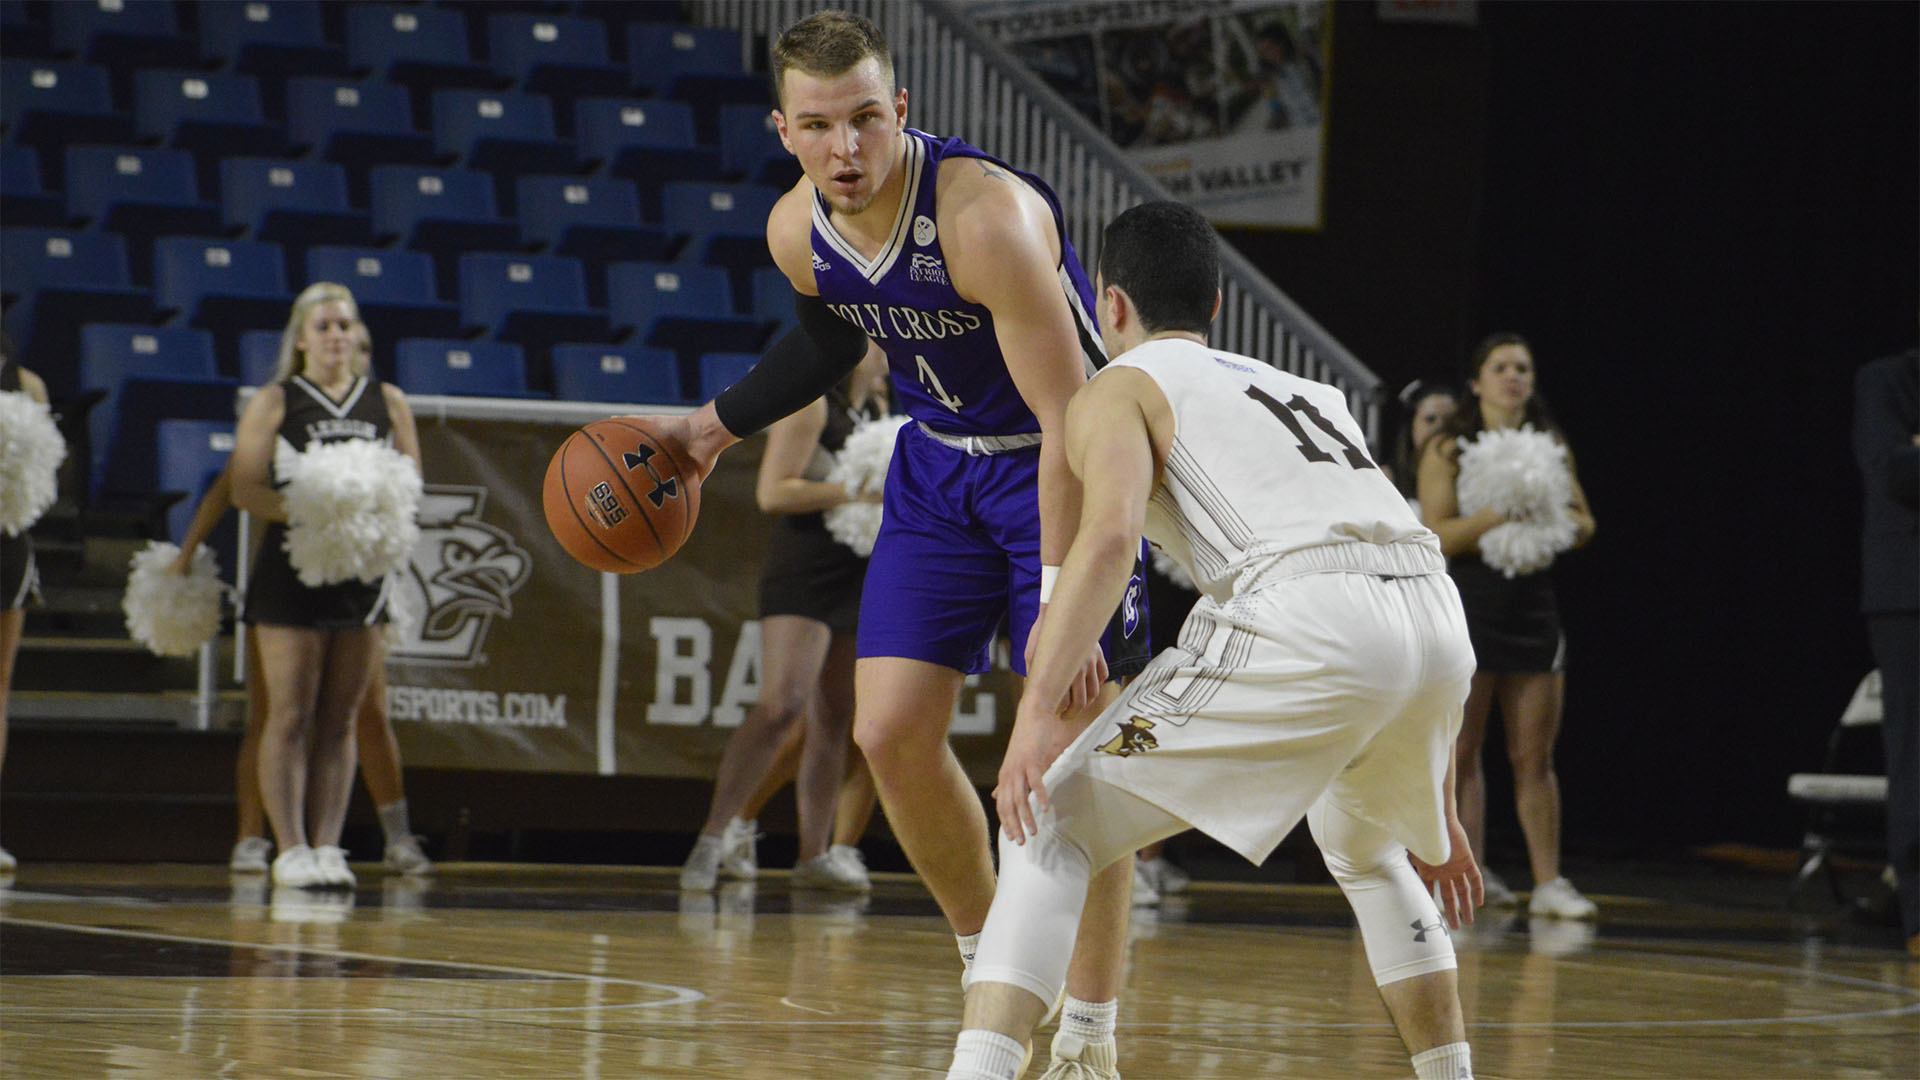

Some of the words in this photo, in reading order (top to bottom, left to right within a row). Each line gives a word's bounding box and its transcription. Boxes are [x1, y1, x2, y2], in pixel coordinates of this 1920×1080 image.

[1197, 158, 1304, 191] VALLEY
[910, 265, 945, 278] PATRIOT
[911, 274, 950, 286] LEAGUE
[827, 304, 888, 339] OLY
[888, 306, 981, 340] CROSS
[1243, 383, 1376, 470] 11
[593, 481, 628, 525] 695
